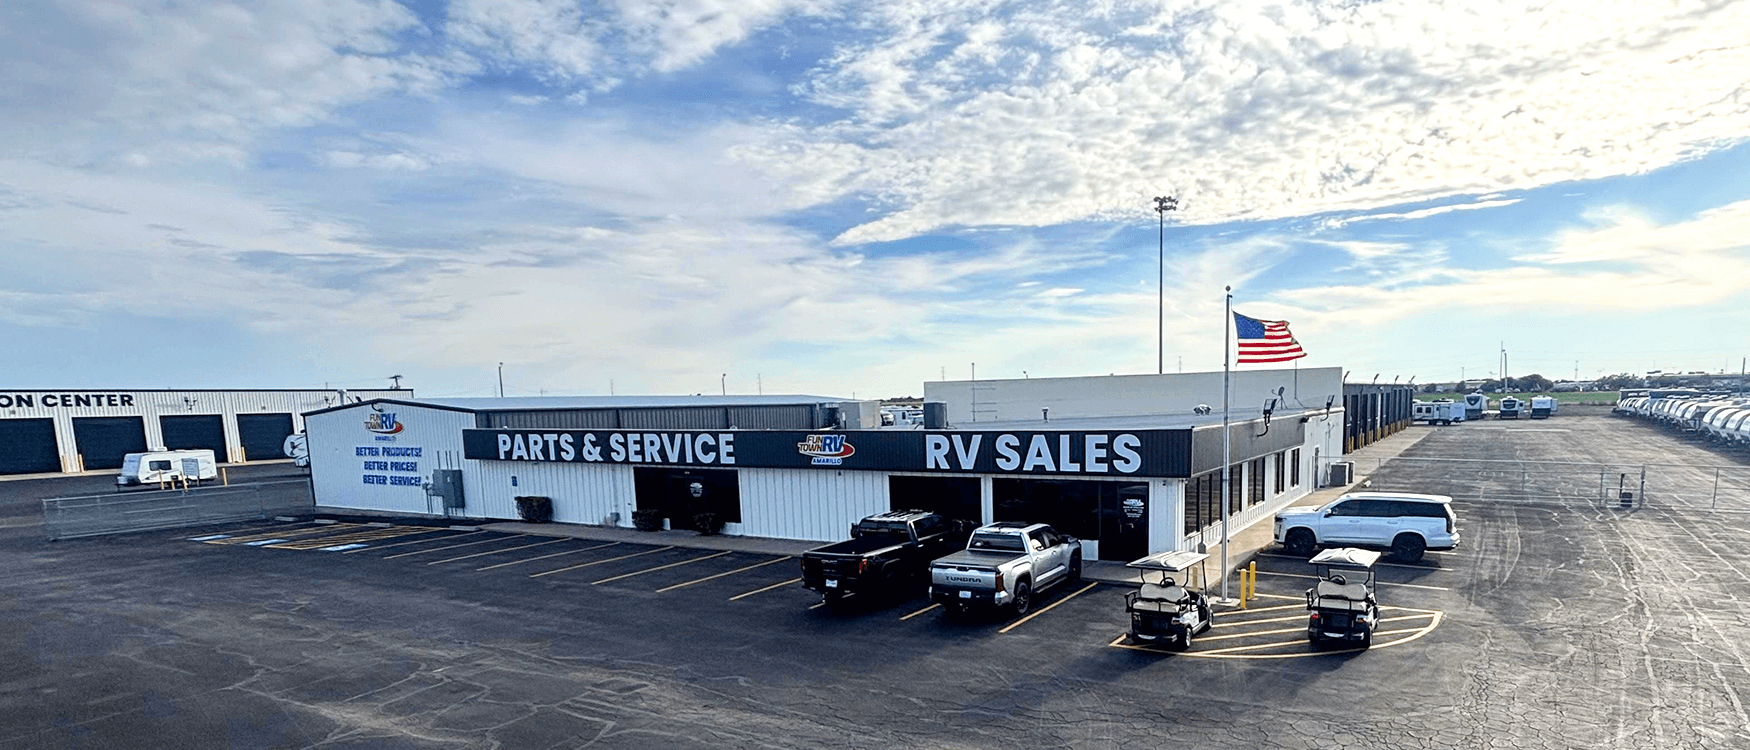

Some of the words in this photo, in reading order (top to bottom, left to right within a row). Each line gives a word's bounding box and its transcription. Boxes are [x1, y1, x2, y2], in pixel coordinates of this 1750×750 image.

[0, 395, 33, 408] ON
[42, 394, 134, 407] CENTER
[381, 413, 396, 429] RV
[807, 435, 823, 444] FUN
[823, 435, 845, 452] RV
[356, 447, 379, 456] BETTER
[382, 447, 422, 457] PRODUCTS!
[498, 433, 575, 461] PARTS
[582, 433, 604, 461] &
[609, 433, 736, 464] SERVICE
[799, 444, 823, 452] TOWN
[925, 434, 983, 470] RV
[995, 433, 1142, 473] SALES
[364, 461, 388, 471] BETTER
[390, 461, 417, 472] PRICES!
[363, 475, 388, 485] BETTER
[390, 476, 421, 486] SERVICE!
